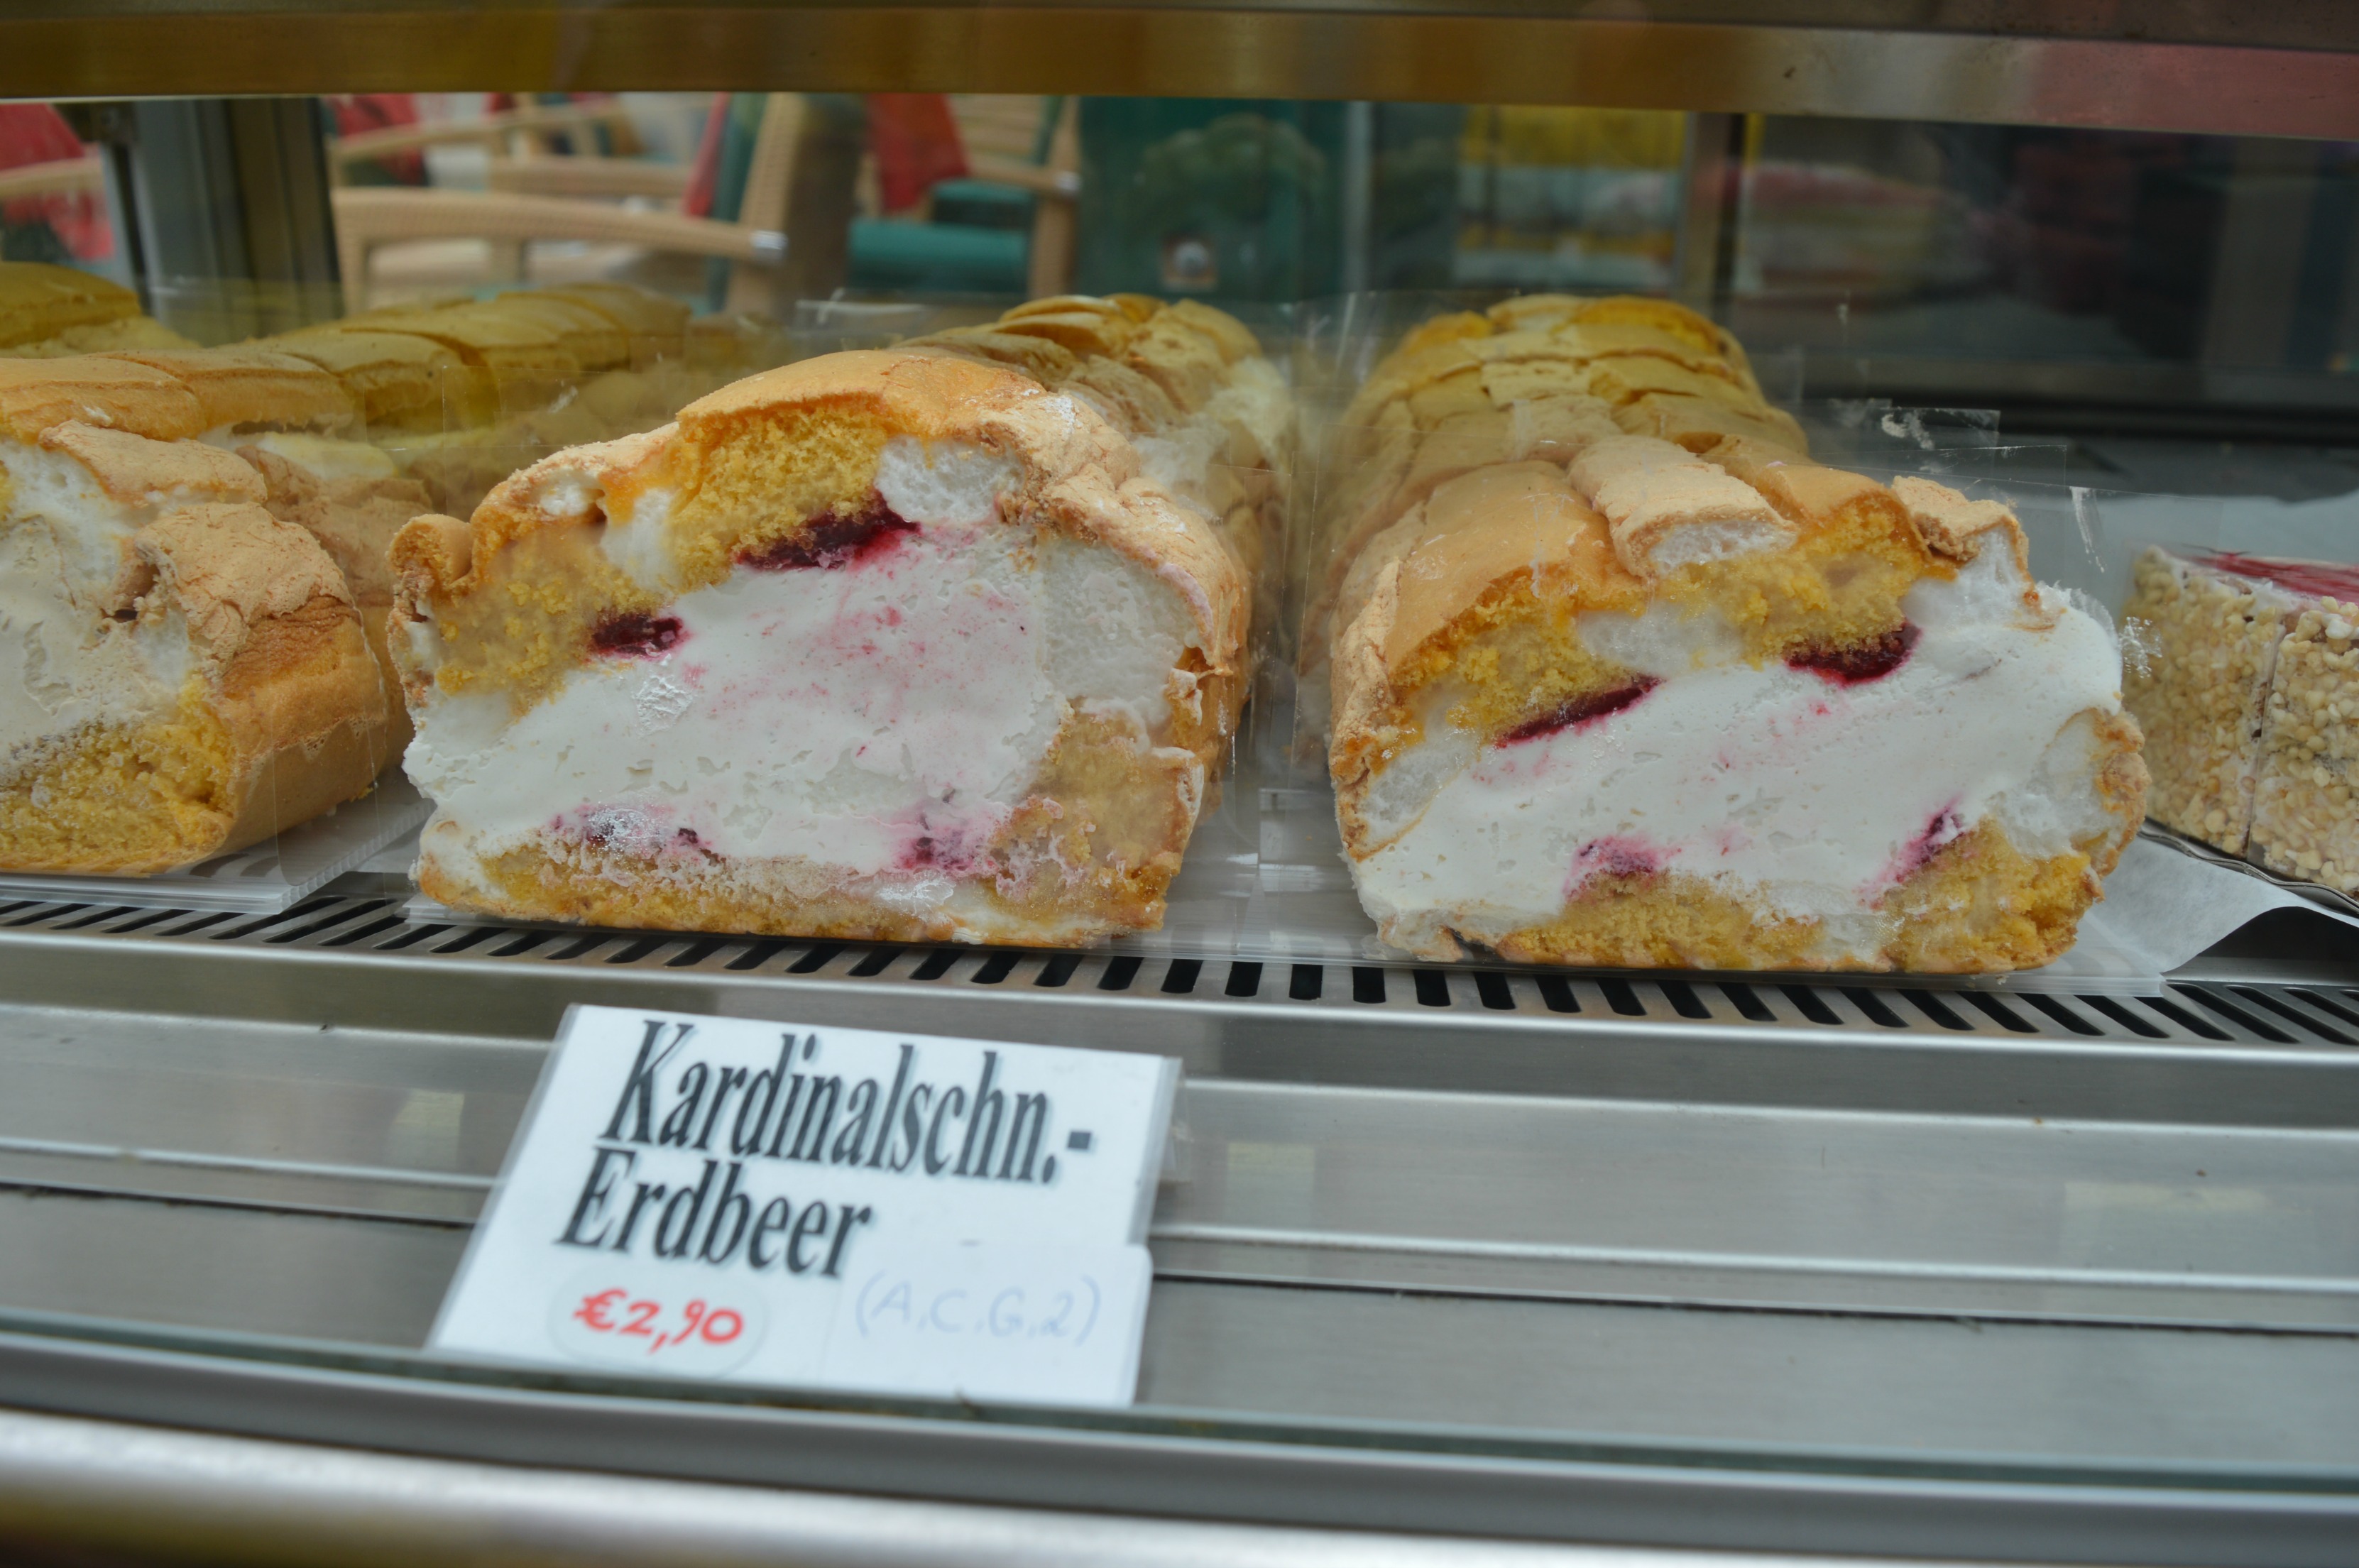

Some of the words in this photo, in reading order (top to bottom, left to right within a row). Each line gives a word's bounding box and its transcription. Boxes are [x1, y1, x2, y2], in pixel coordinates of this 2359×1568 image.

[598, 1020, 1093, 1183] Kardinalschn.-
[555, 1146, 872, 1276] Erdbeer
[573, 1288, 744, 1353] €2,90
